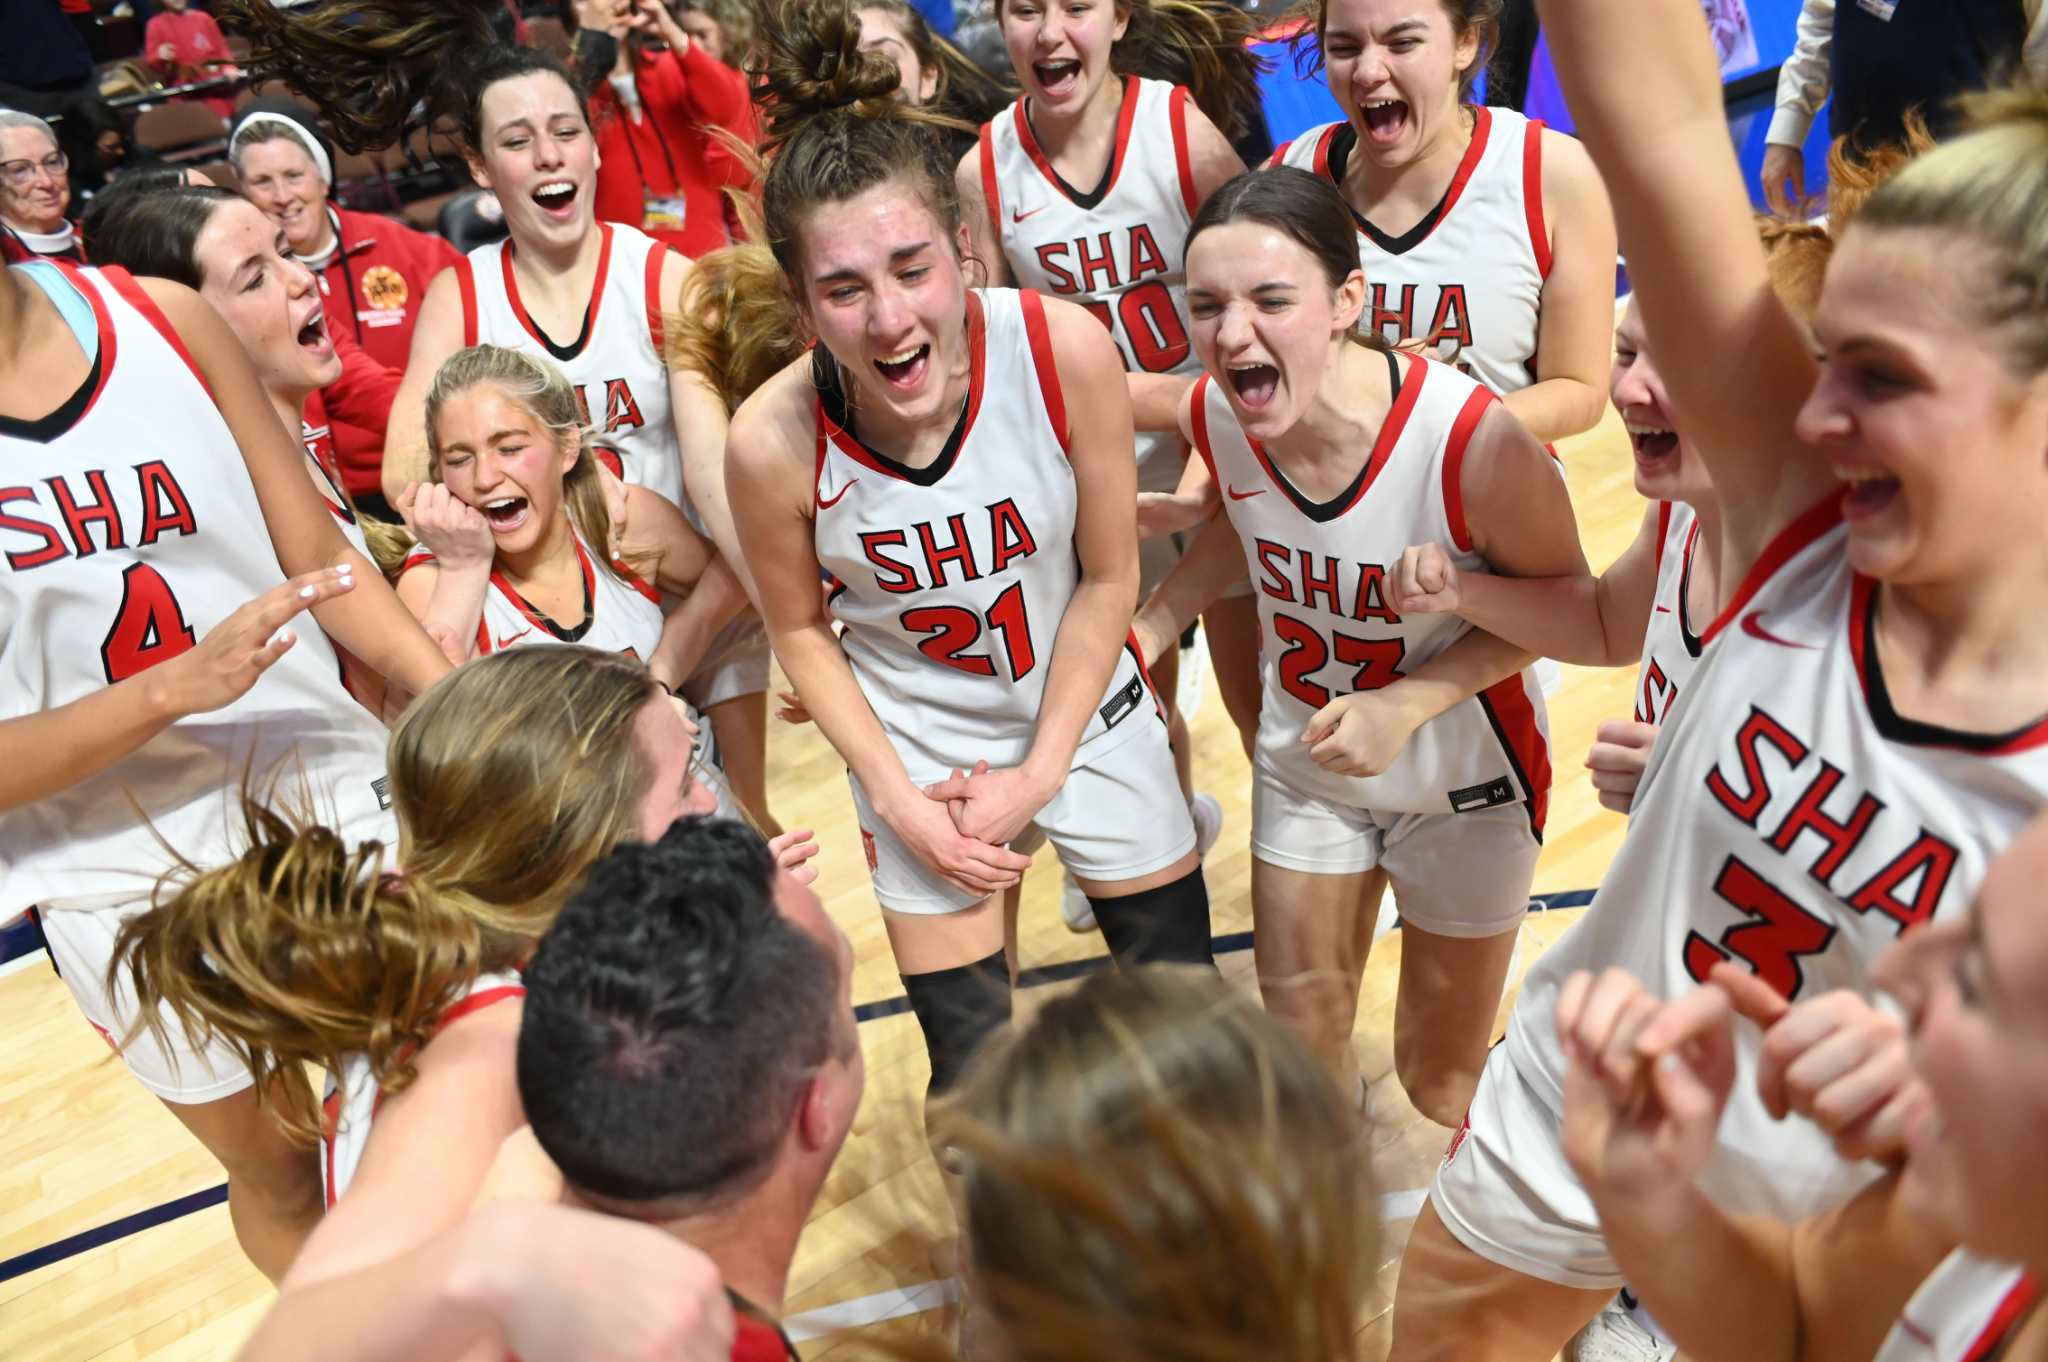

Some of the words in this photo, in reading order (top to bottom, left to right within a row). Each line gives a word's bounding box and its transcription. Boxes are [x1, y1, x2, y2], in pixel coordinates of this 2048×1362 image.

[1034, 223, 1168, 294] SHA
[1369, 283, 1474, 348] HA
[0, 460, 197, 571] SHA
[857, 497, 1037, 594] SHA
[100, 561, 197, 684] 4
[900, 580, 1035, 683] 21
[1254, 537, 1402, 625] SHA
[1704, 703, 1962, 939] SHA
[1682, 852, 1838, 1004] 3
